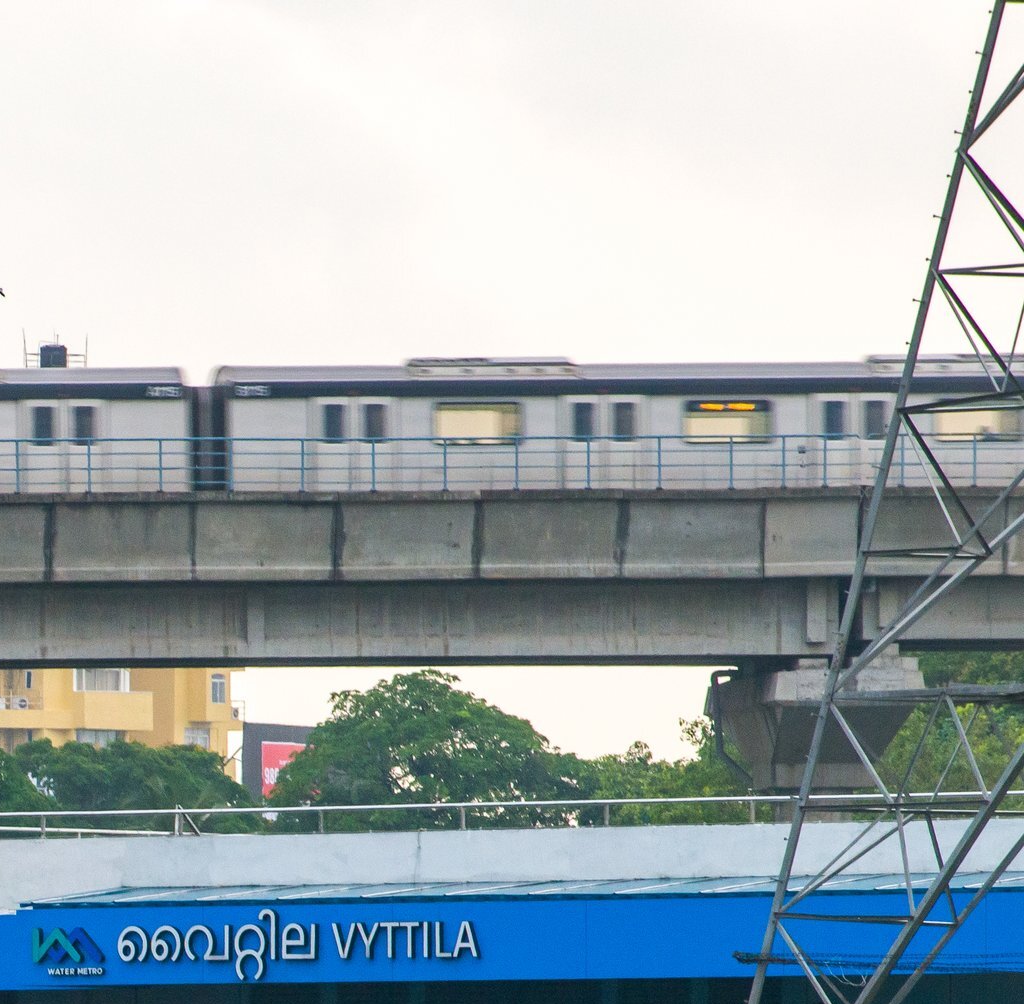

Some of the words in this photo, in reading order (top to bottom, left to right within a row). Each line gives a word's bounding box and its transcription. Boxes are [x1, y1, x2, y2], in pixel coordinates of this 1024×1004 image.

[116, 908, 317, 980] വൈറ്റില
[332, 921, 478, 958] VYTTILA
[47, 967, 75, 975] WATER
[77, 967, 103, 975] METRO
